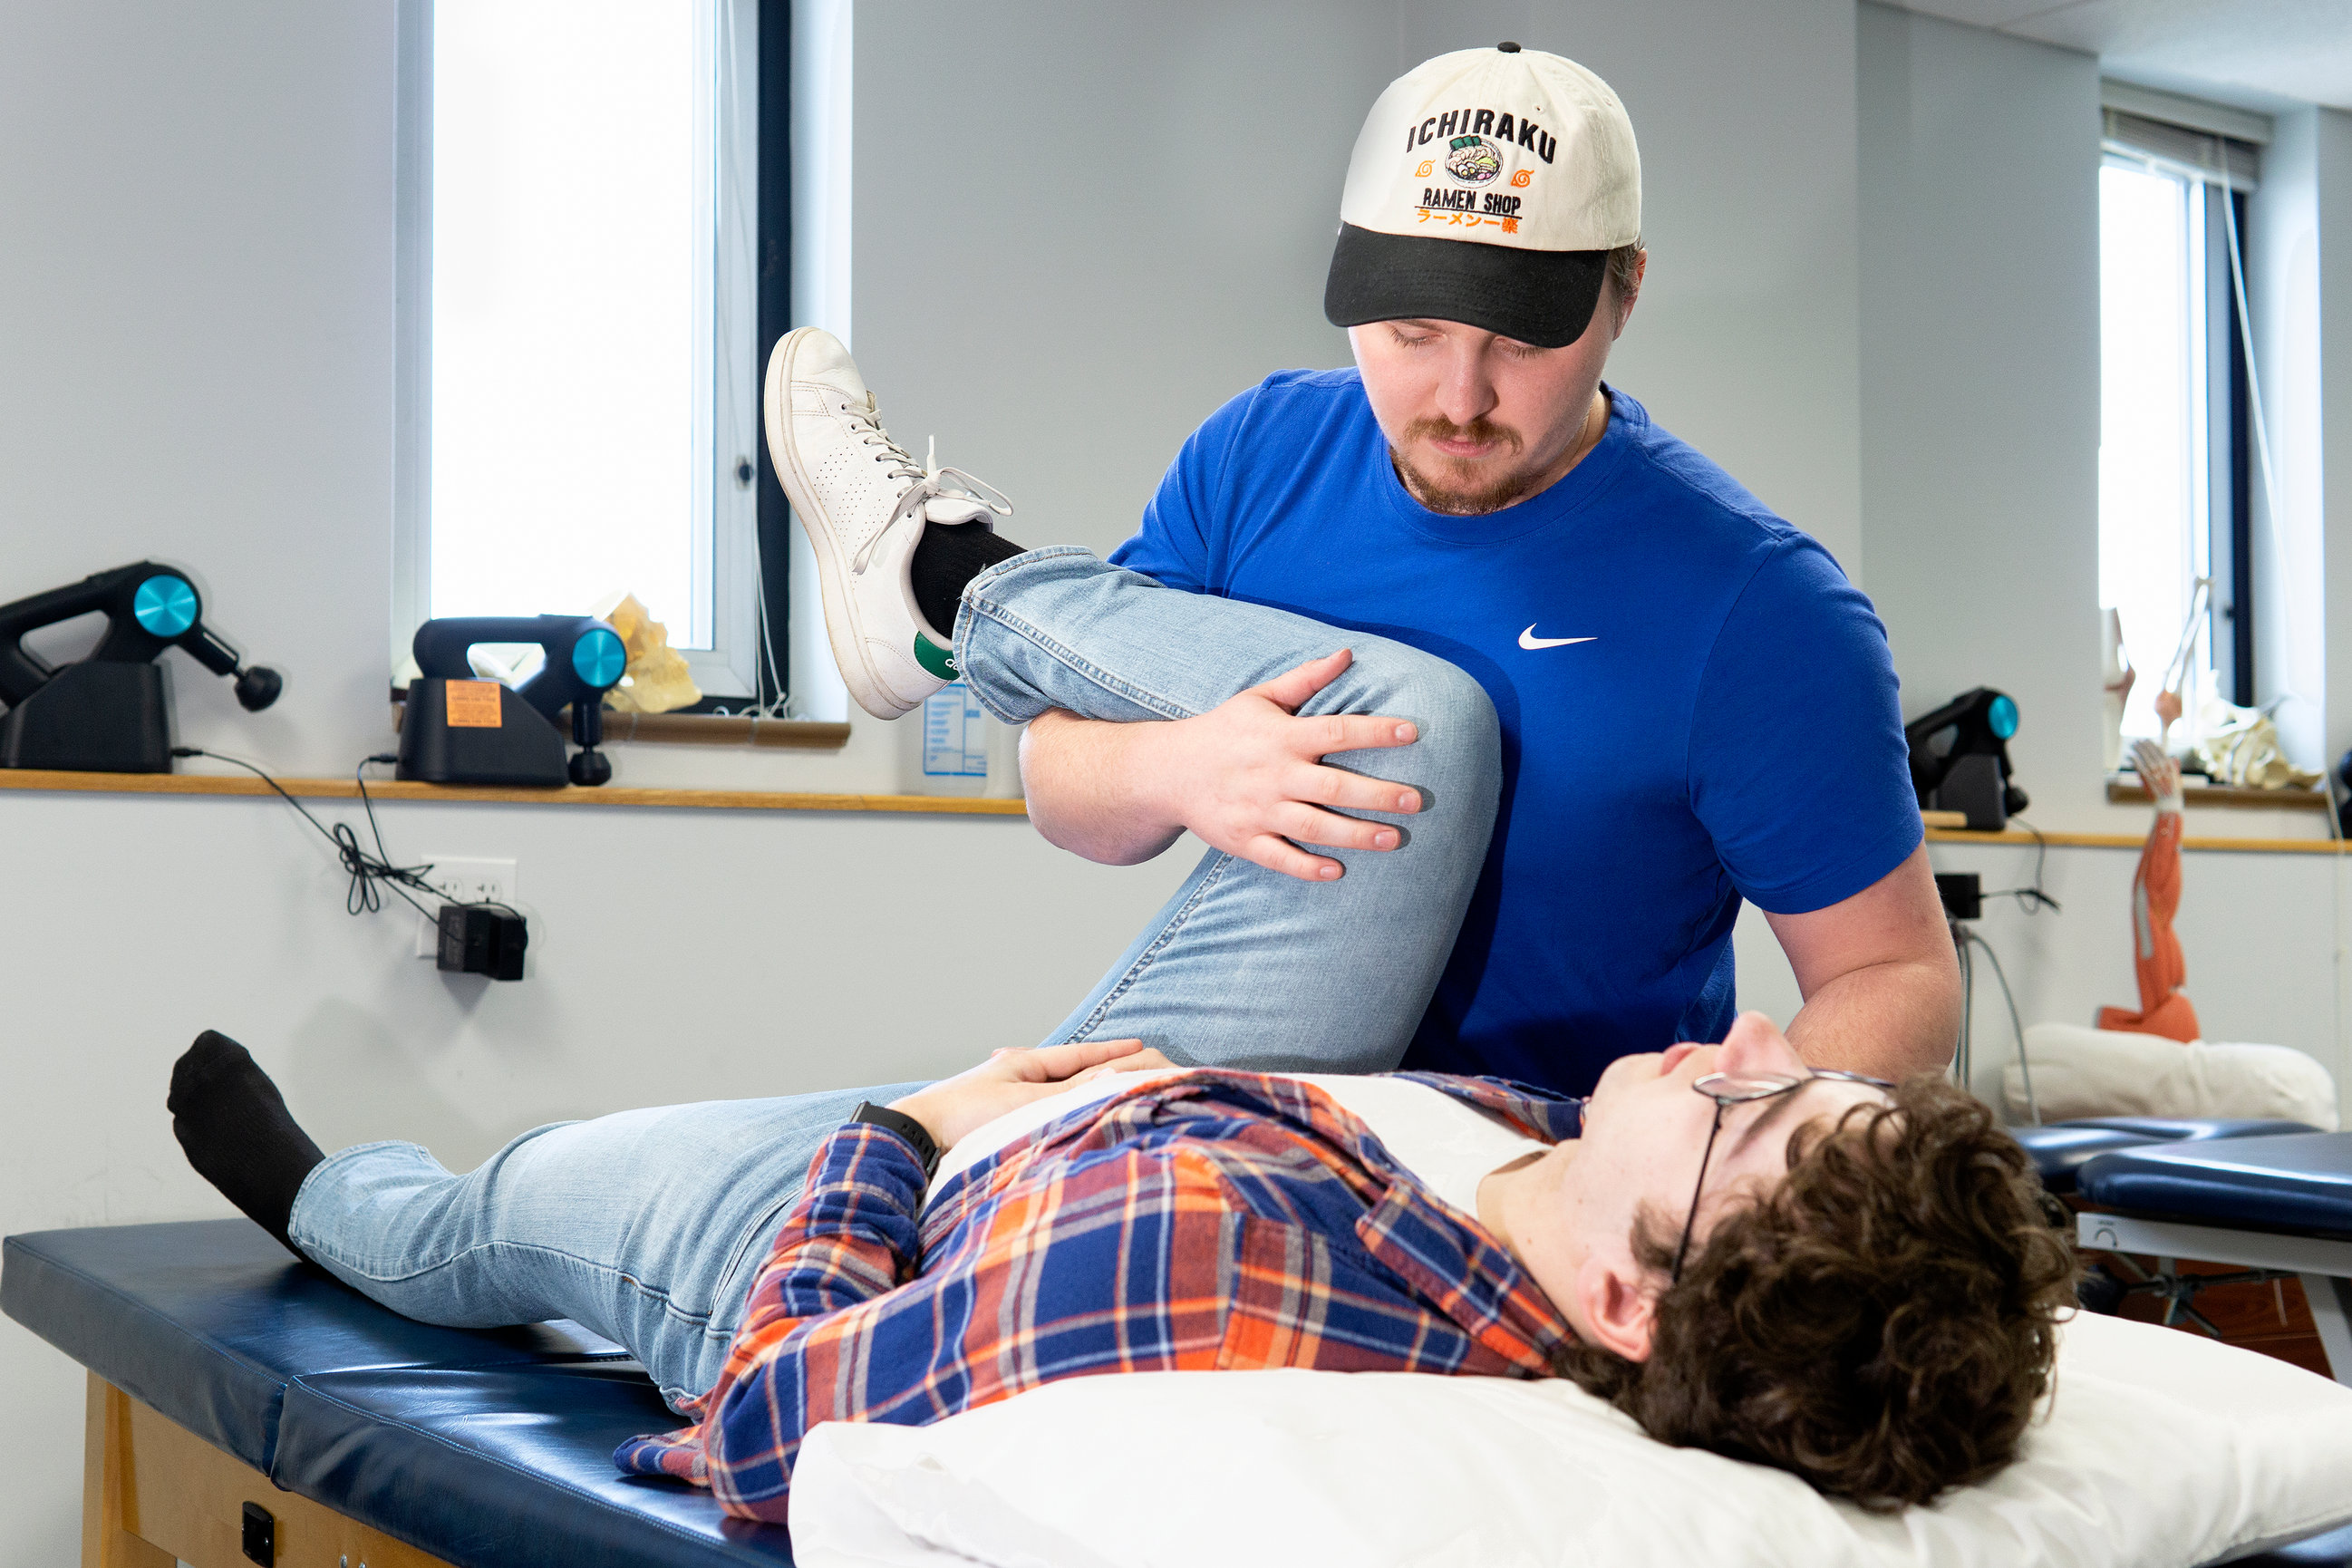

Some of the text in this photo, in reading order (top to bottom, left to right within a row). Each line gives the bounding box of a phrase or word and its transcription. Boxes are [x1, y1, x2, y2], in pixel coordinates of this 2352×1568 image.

[1407, 109, 1556, 164] ICHIRAKU
[1423, 188, 1521, 215] RAMEN SHOP
